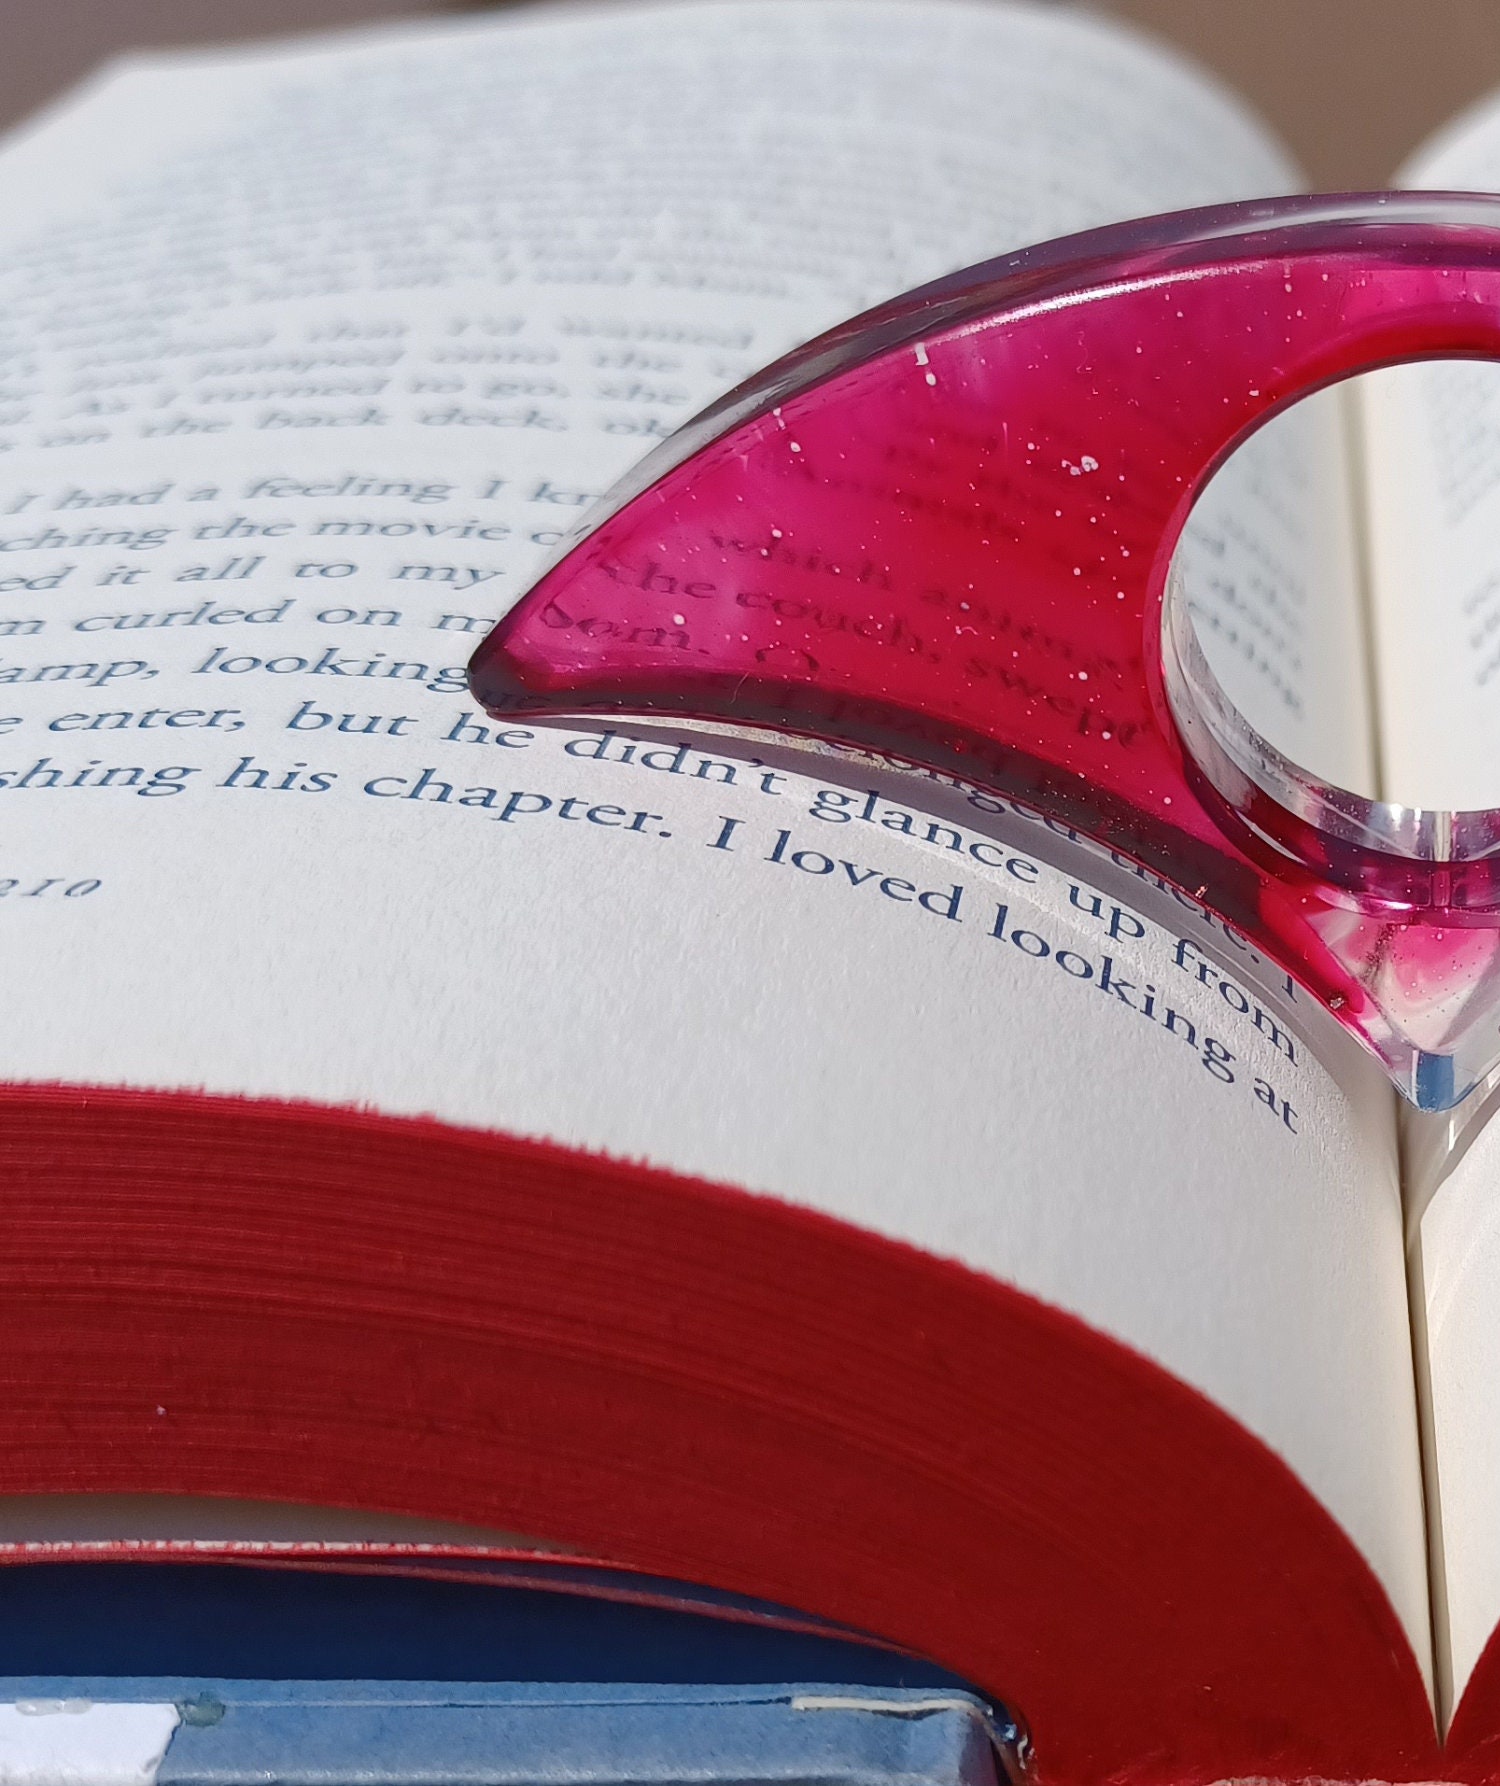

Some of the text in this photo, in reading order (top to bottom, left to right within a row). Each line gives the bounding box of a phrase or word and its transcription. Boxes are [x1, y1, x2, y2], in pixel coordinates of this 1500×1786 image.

[253, 403, 391, 430] back
[413, 404, 571, 433] deck,
[50, 477, 178, 511] had
[184, 487, 221, 503] a
[241, 476, 459, 506] feeling
[481, 478, 512, 501] I
[192, 515, 297, 541] the
[309, 518, 511, 542] movie
[97, 565, 152, 587] it
[173, 555, 268, 583] all
[293, 562, 360, 579] to
[388, 564, 507, 591] my
[73, 598, 299, 634] curled
[315, 607, 404, 627] on
[0, 648, 469, 693] amp, looking
[48, 707, 247, 733] enter,
[284, 700, 419, 738] but
[439, 712, 535, 749] he
[564, 729, 788, 796] didn't
[807, 789, 1040, 885] glance
[1067, 882, 1147, 944] up
[1170, 937, 1300, 1068] from
[214, 756, 339, 793] his
[363, 768, 673, 839] chapter.
[705, 814, 747, 853] I
[762, 828, 964, 924] loved
[986, 901, 1237, 1085] looking
[1252, 1076, 1299, 1135] at
